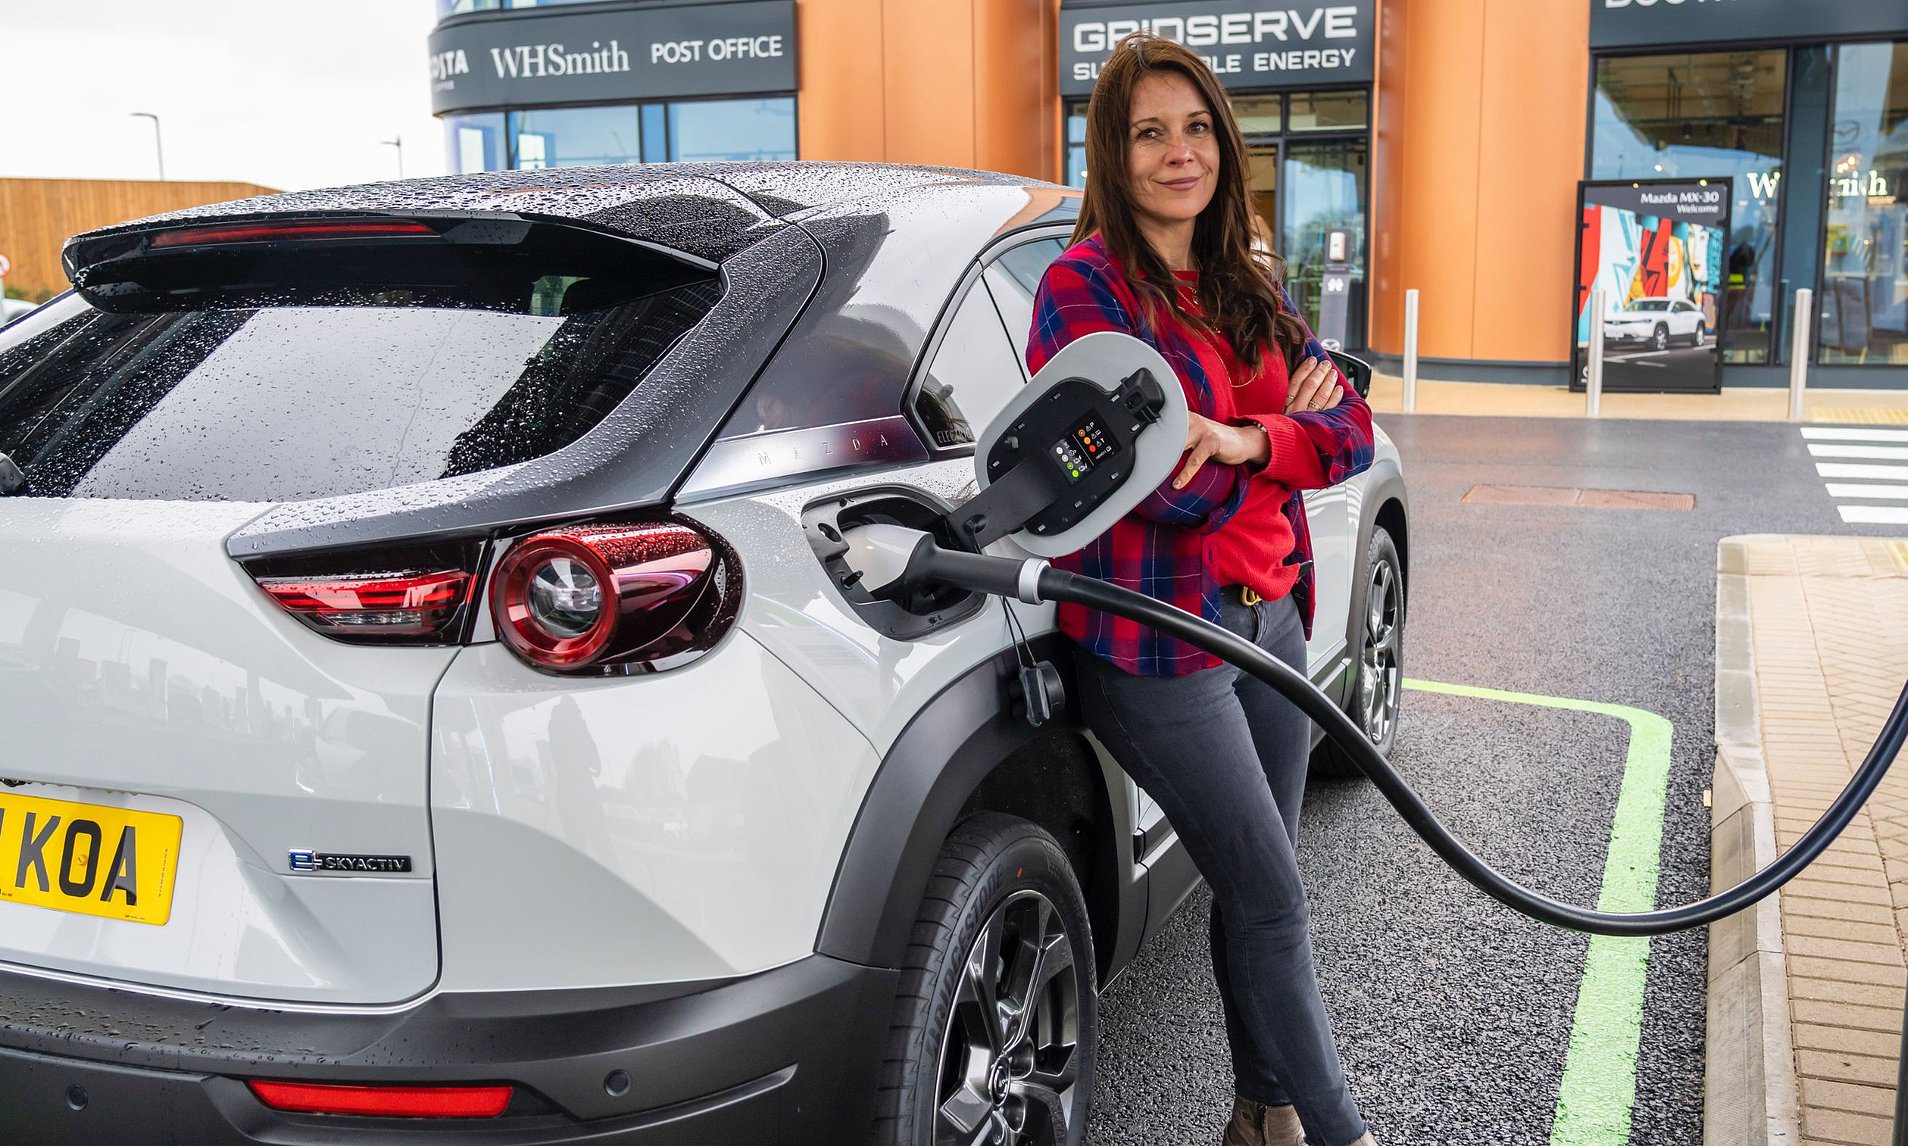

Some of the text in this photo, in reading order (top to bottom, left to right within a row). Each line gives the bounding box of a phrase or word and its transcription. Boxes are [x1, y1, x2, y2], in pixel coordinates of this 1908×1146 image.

[1073, 7, 1357, 53] GRIDSERVE
[490, 40, 631, 79] WHSmith
[651, 35, 783, 64] POST OFFICE
[1253, 48, 1355, 72] ENERGY
[1640, 190, 1720, 204] Mazda MX-30
[1676, 203, 1719, 214] Welcome
[15, 811, 138, 906] KOA
[325, 856, 405, 871] SKYACTIV
